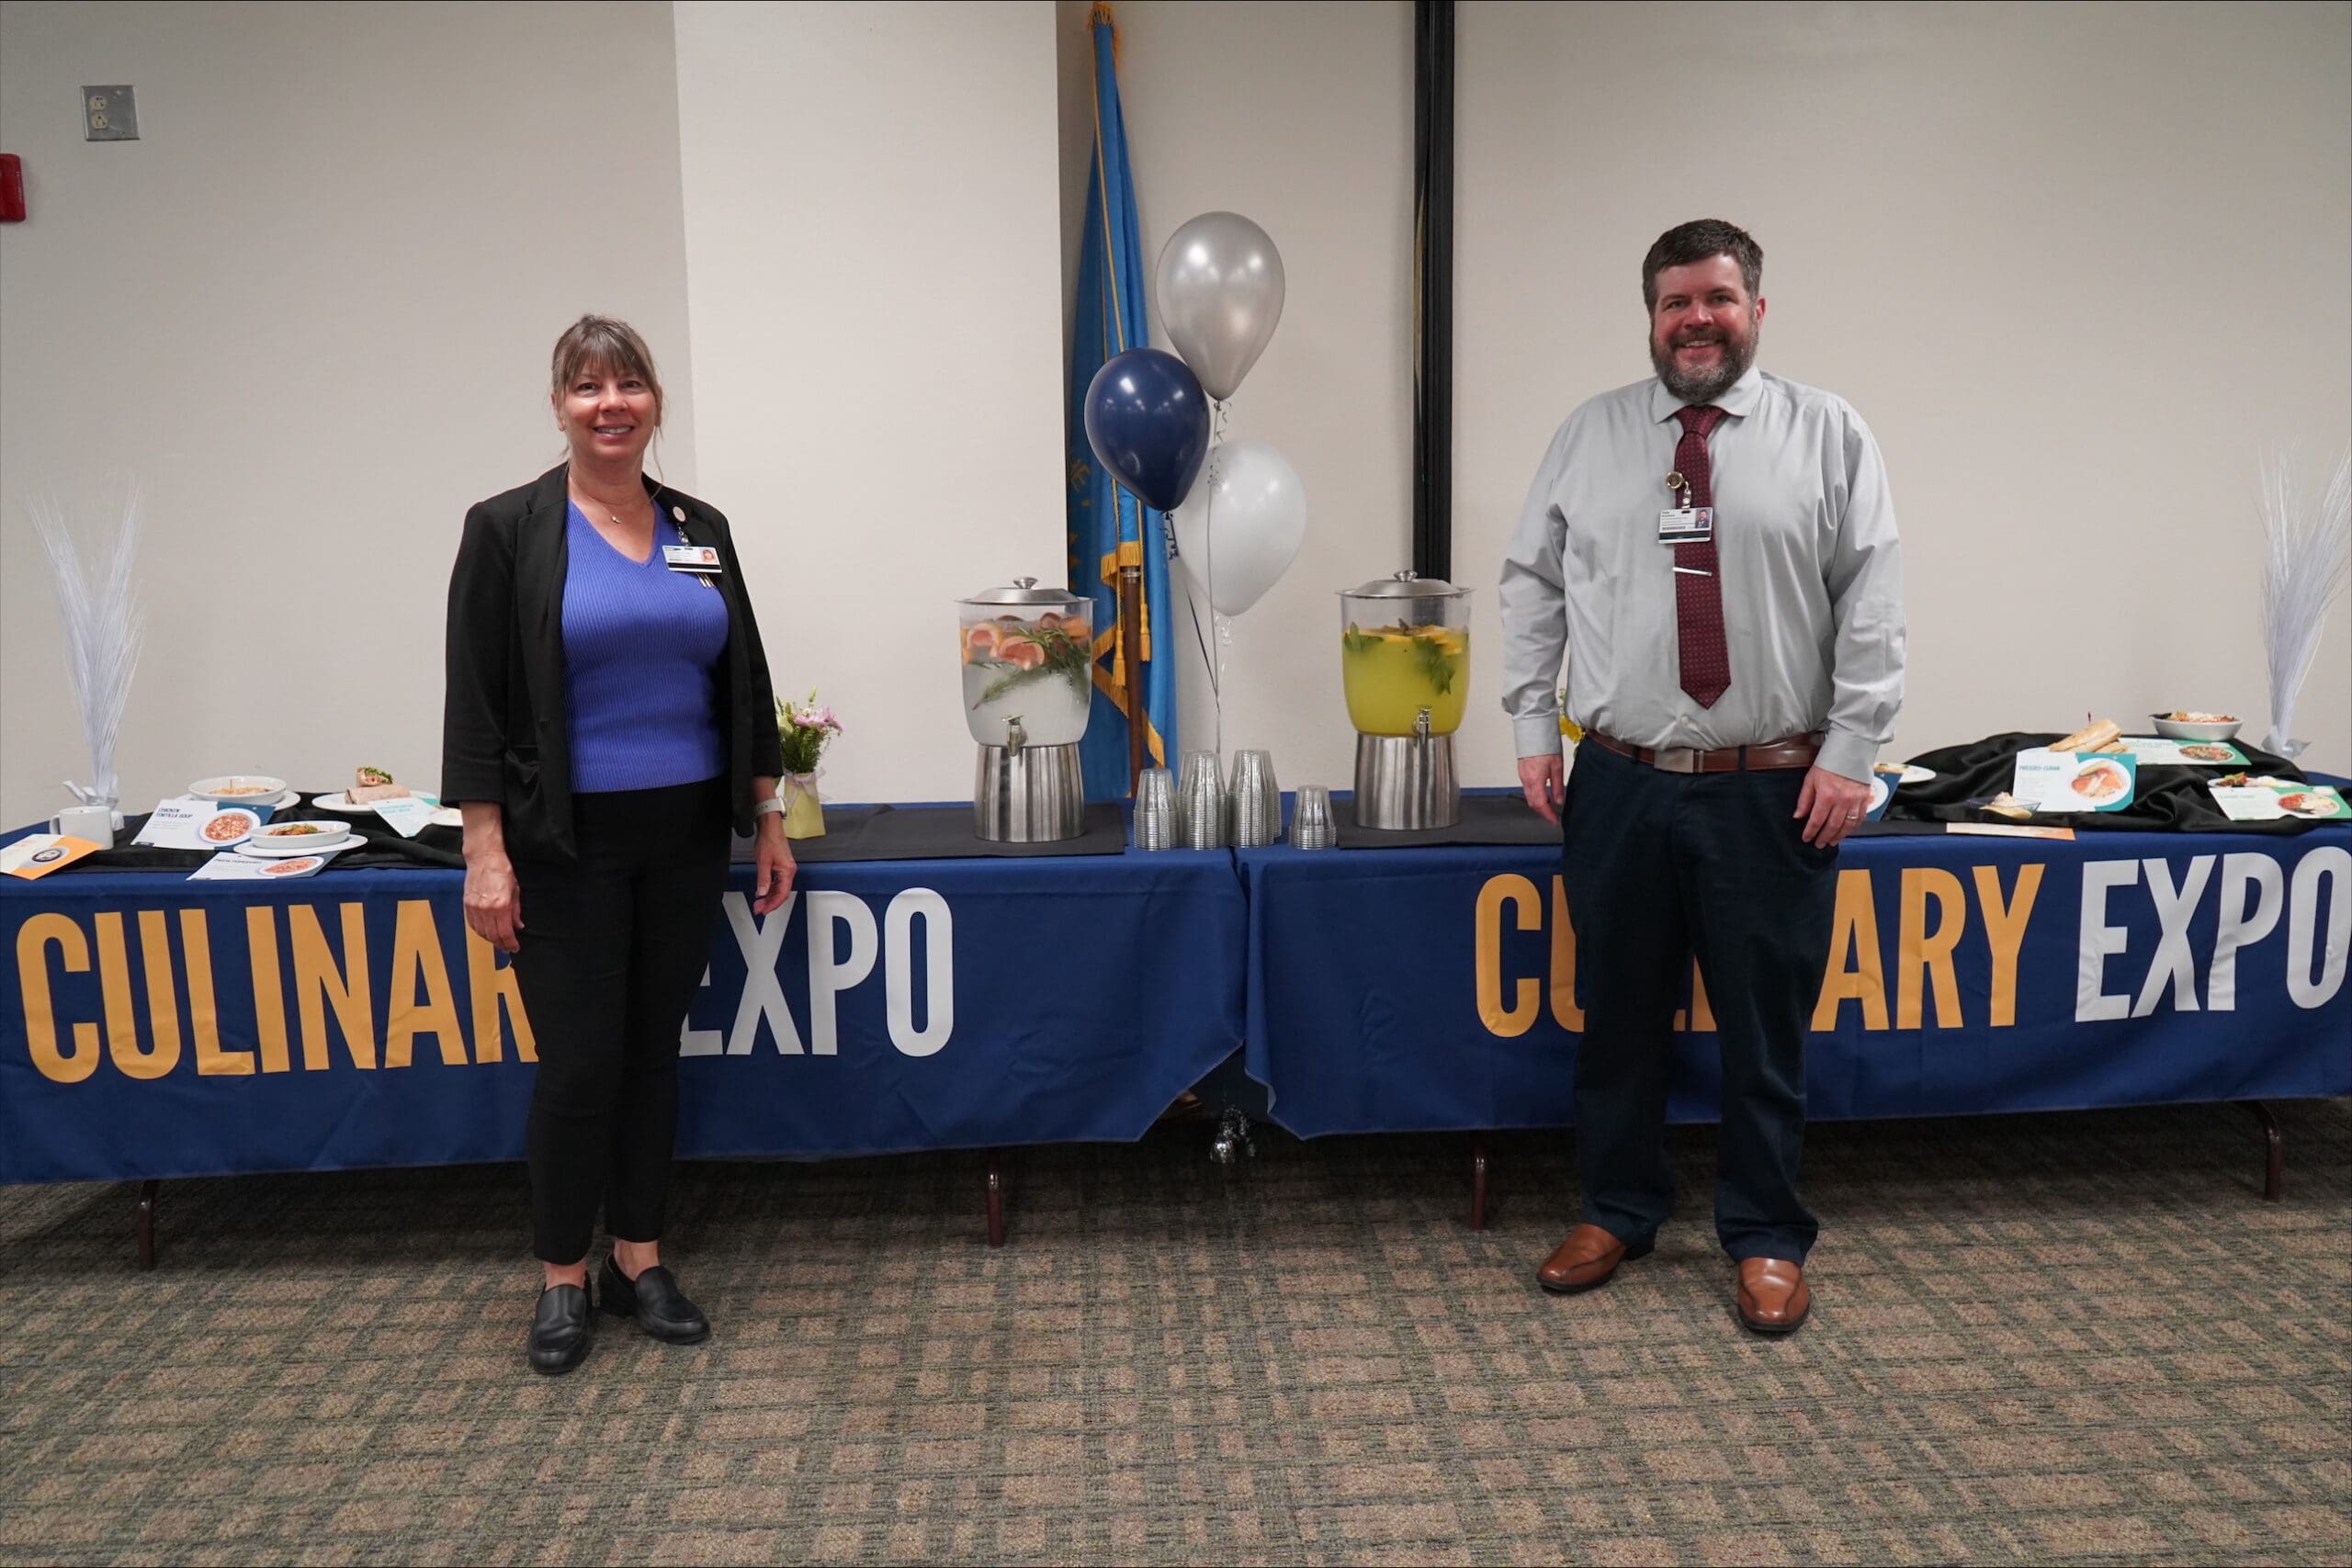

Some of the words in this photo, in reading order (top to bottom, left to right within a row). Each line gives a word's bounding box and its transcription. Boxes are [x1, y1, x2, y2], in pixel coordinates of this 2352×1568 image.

[17, 899, 539, 1083] CULINAR
[679, 887, 954, 1057] XPO
[2075, 846, 2352, 1022] EXPO
